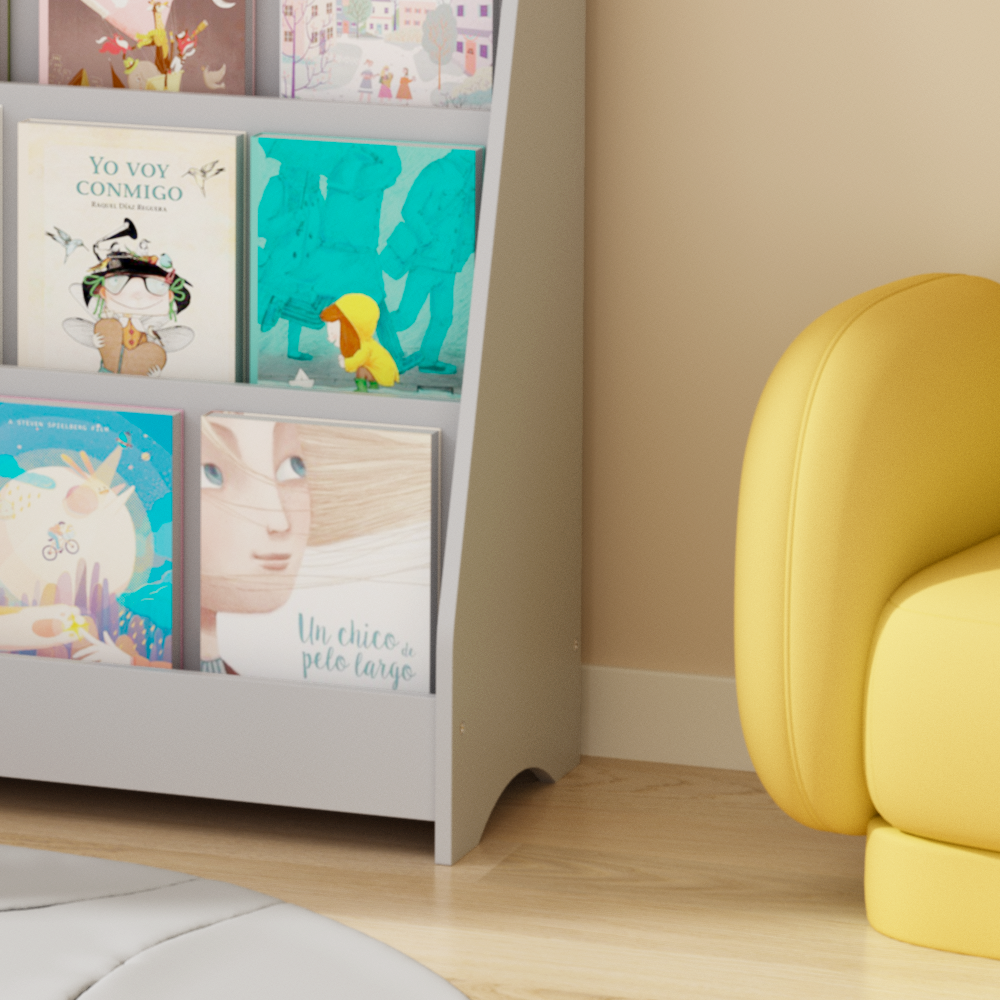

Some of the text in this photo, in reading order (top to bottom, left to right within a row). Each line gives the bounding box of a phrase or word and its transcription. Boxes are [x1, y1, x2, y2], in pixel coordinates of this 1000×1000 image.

[126, 161, 170, 179] VOY
[76, 179, 184, 202] CONMIGO
[16, 418, 44, 427] STEVEN
[46, 421, 87, 431] SPIELBERG
[298, 612, 417, 657] Un chico de
[302, 646, 417, 691] pelo largo
